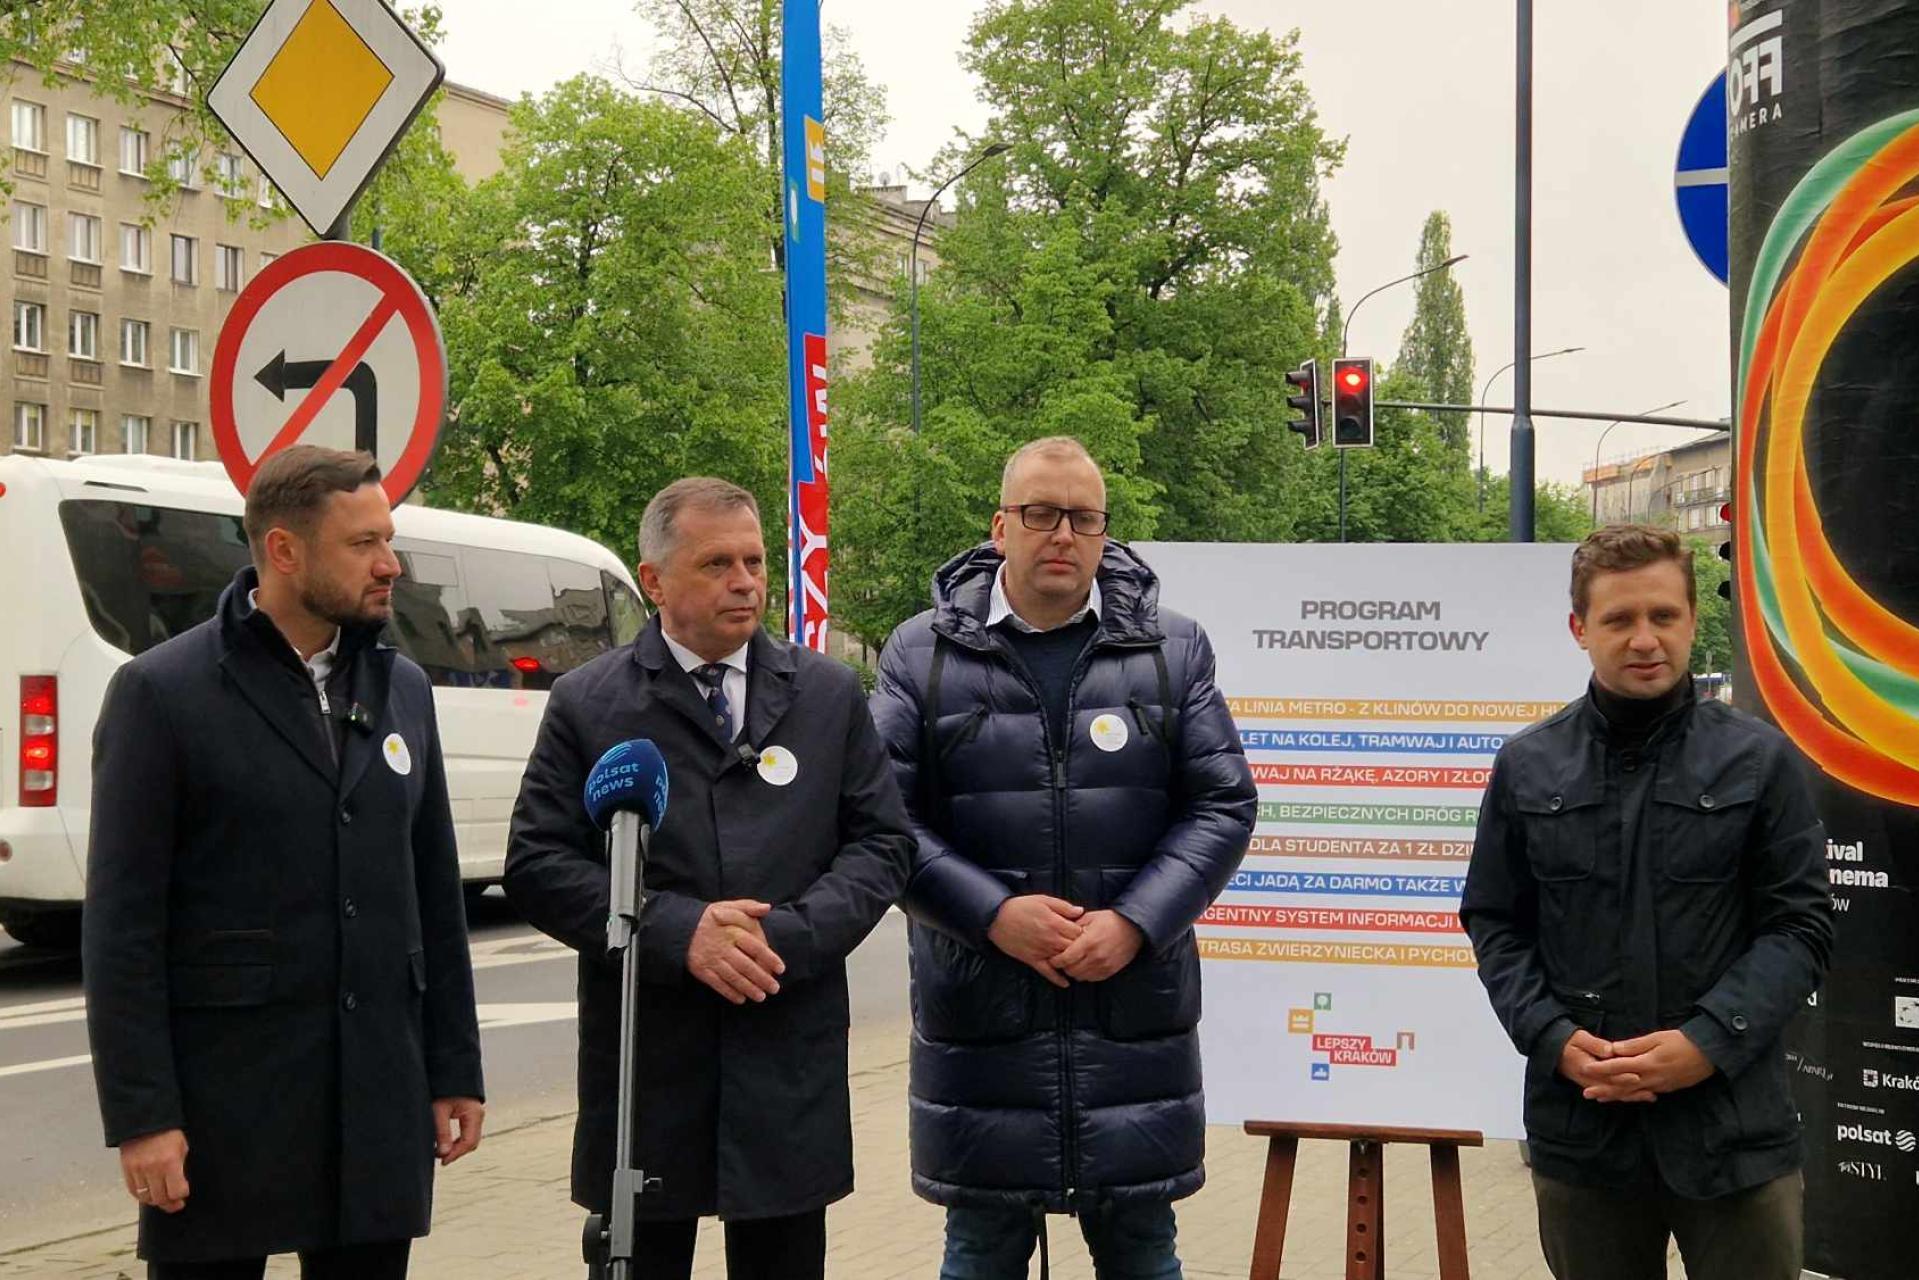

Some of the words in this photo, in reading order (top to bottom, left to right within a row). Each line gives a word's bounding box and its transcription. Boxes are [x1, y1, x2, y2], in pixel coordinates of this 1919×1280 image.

[1301, 600, 1441, 621] PROGRAM
[1252, 629, 1489, 652] TRANSPORTOWY
[1244, 701, 1285, 714] LINIA
[1288, 702, 1347, 715] METRO
[1359, 703, 1369, 715] Z
[1373, 700, 1441, 716] KLINÓW
[1445, 704, 1468, 717] DO
[1472, 705, 1537, 718] NOWEJ
[1272, 733, 1295, 746] NA
[1299, 734, 1356, 748] KOLEJ,
[1359, 735, 1445, 748] TRAMWAJ
[1449, 737, 1454, 748] I
[588, 763, 640, 796] polsat
[1293, 768, 1316, 780] NA
[1321, 765, 1379, 784] RŻĄKĘ,
[1382, 769, 1442, 783] AZORY
[1444, 771, 1448, 782] I
[592, 777, 634, 802] news
[1280, 806, 1408, 821] BEZPIECZNYCH
[1413, 806, 1461, 822] DRÓG
[1249, 838, 1281, 851] DLA
[1285, 839, 1375, 854] STUDENTA
[1378, 841, 1400, 854] ZA
[1406, 842, 1412, 855] 1
[1417, 842, 1438, 856] ZŁ
[1254, 874, 1300, 890] JADĄ
[1304, 875, 1326, 889] ZA
[1330, 876, 1392, 890] DARMO
[1396, 876, 1449, 892] TAKŻE
[1200, 907, 1272, 922] GENTNY
[1275, 909, 1344, 925] SYSTEM
[1347, 911, 1453, 928] INFORMACJI
[1200, 941, 1253, 955] TRASA
[1256, 942, 1396, 960] ZWIERZYNIECKA
[1400, 947, 1405, 959] I
[1317, 1036, 1366, 1050] LEPSZY
[1334, 1049, 1392, 1064] KRAKÓW
[1837, 1124, 1892, 1145] polsat
